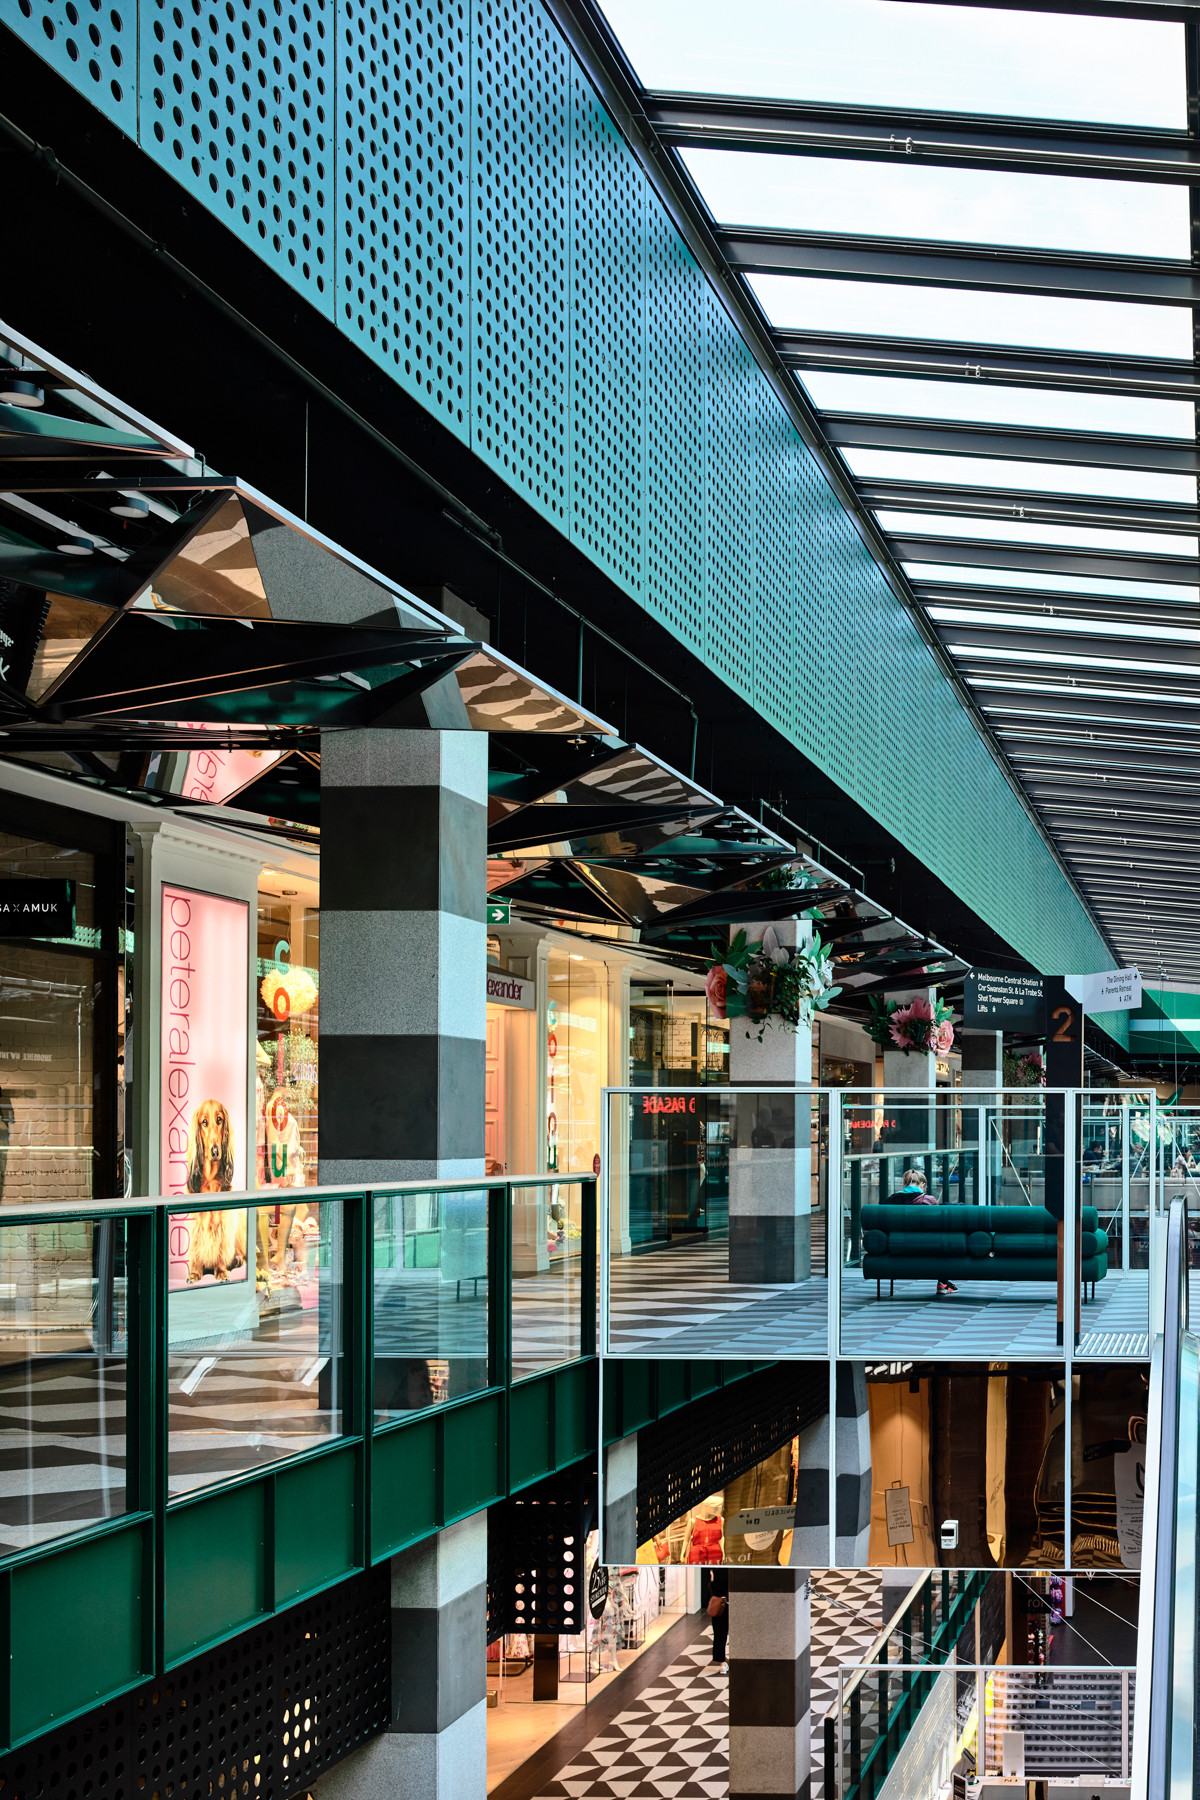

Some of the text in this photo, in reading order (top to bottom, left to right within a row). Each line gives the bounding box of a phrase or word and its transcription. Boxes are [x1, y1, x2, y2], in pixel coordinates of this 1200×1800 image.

[23, 903, 58, 912] AMUK
[977, 973, 1039, 987] Melbourne Central Station
[1113, 975, 1125, 984] Dining
[1124, 973, 1132, 981] Hall
[987, 984, 1009, 993] Swanston
[977, 994, 1018, 1005] Shot Tower Square
[977, 1004, 988, 1013] Lifts
[1052, 1005, 1076, 1043] 2
